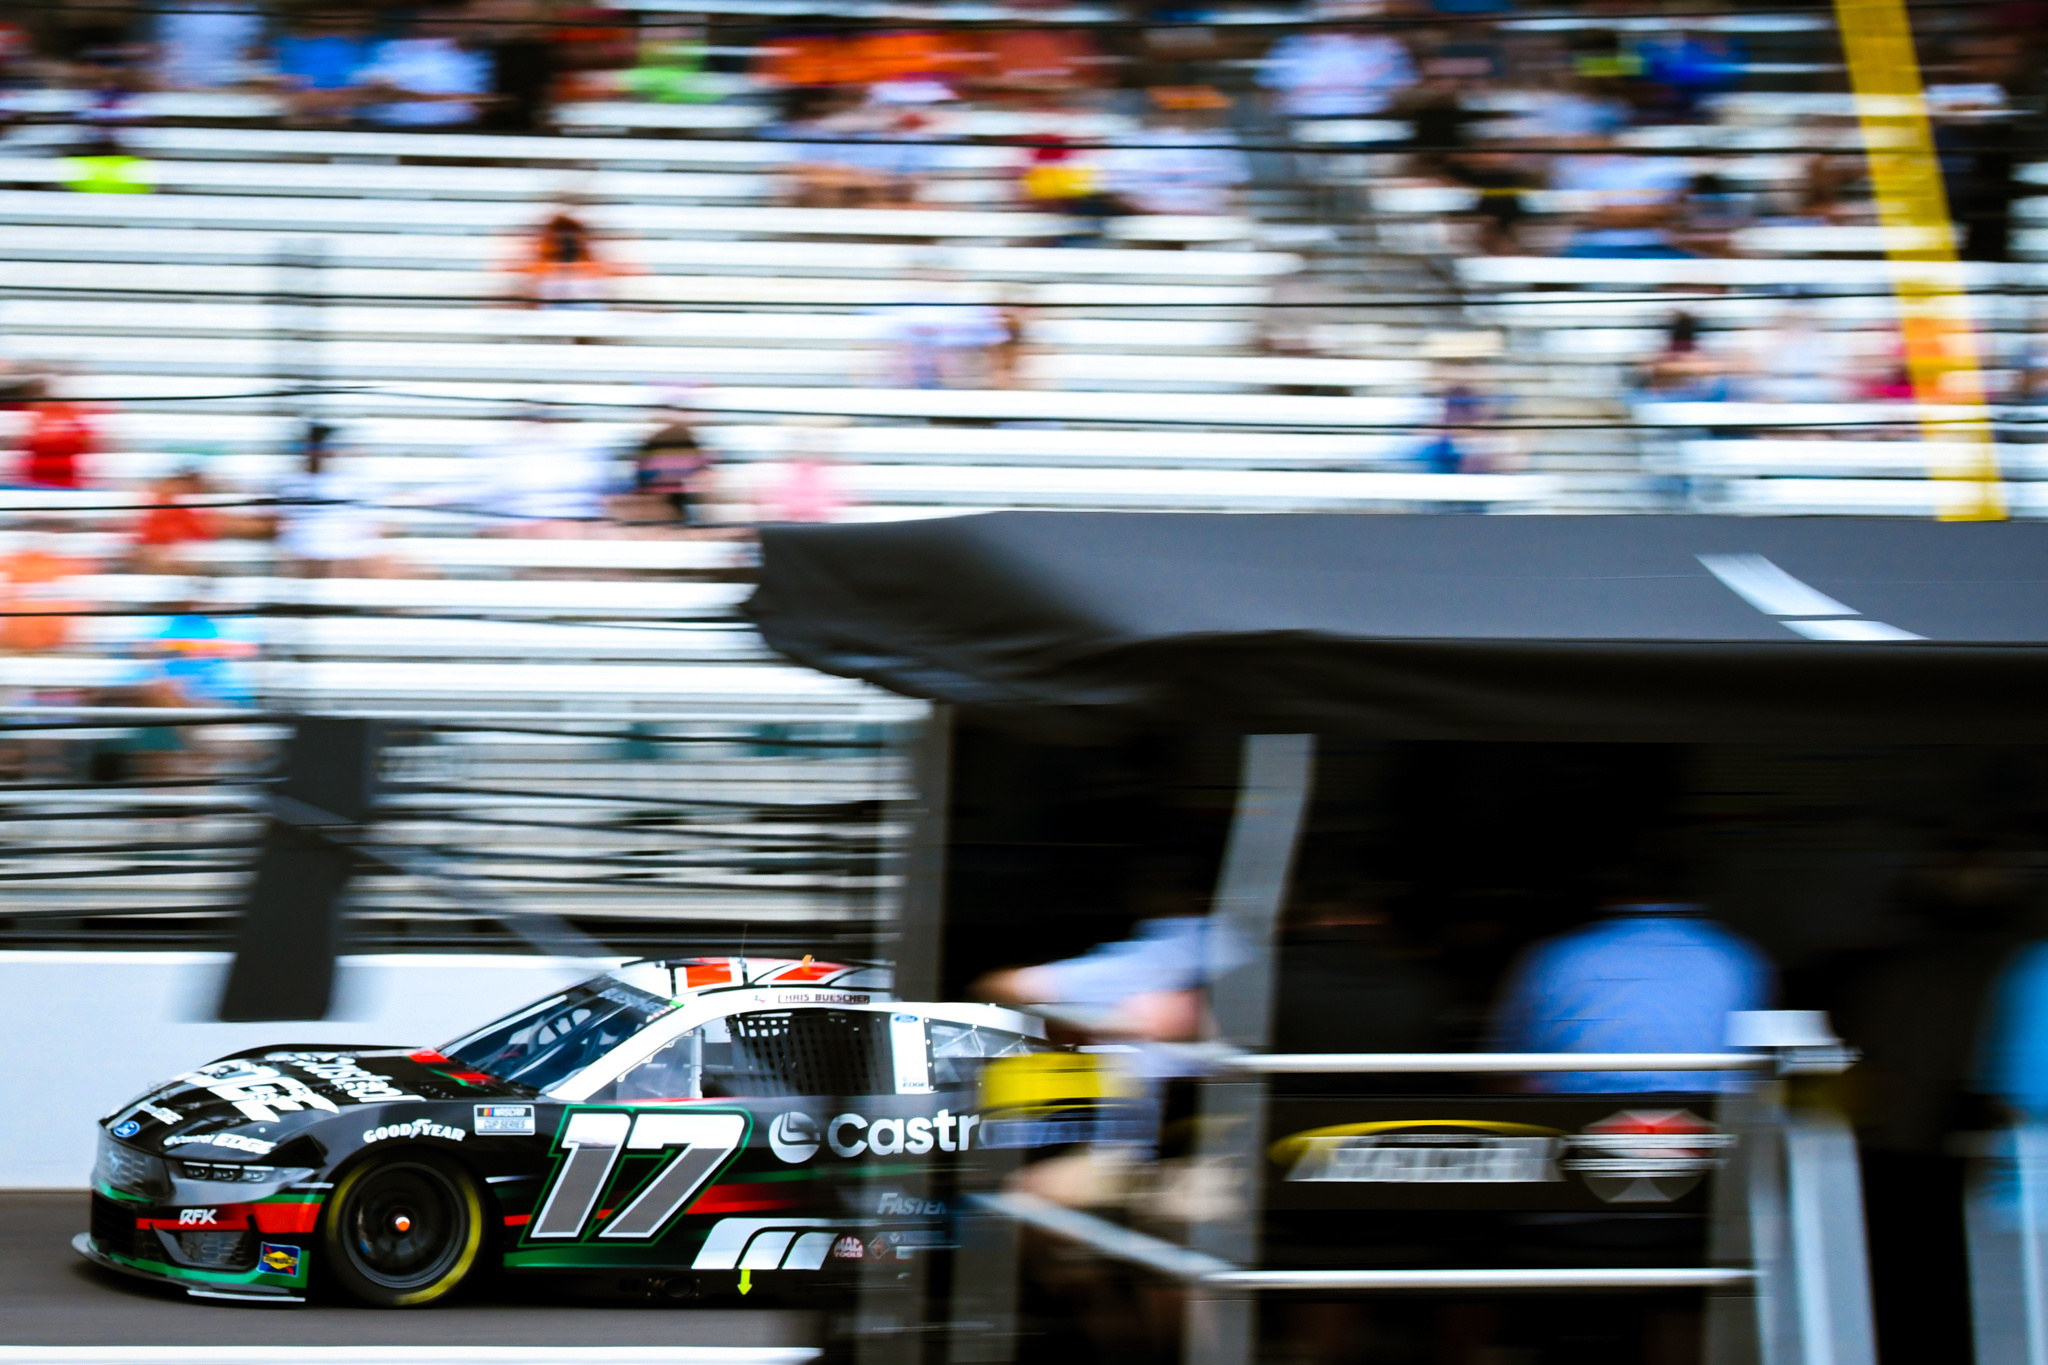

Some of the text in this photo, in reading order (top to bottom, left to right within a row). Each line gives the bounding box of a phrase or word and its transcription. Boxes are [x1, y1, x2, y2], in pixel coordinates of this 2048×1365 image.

[363, 1120, 466, 1143] GOODYEAR
[827, 1109, 980, 1158] Castr
[531, 1113, 746, 1238] 17
